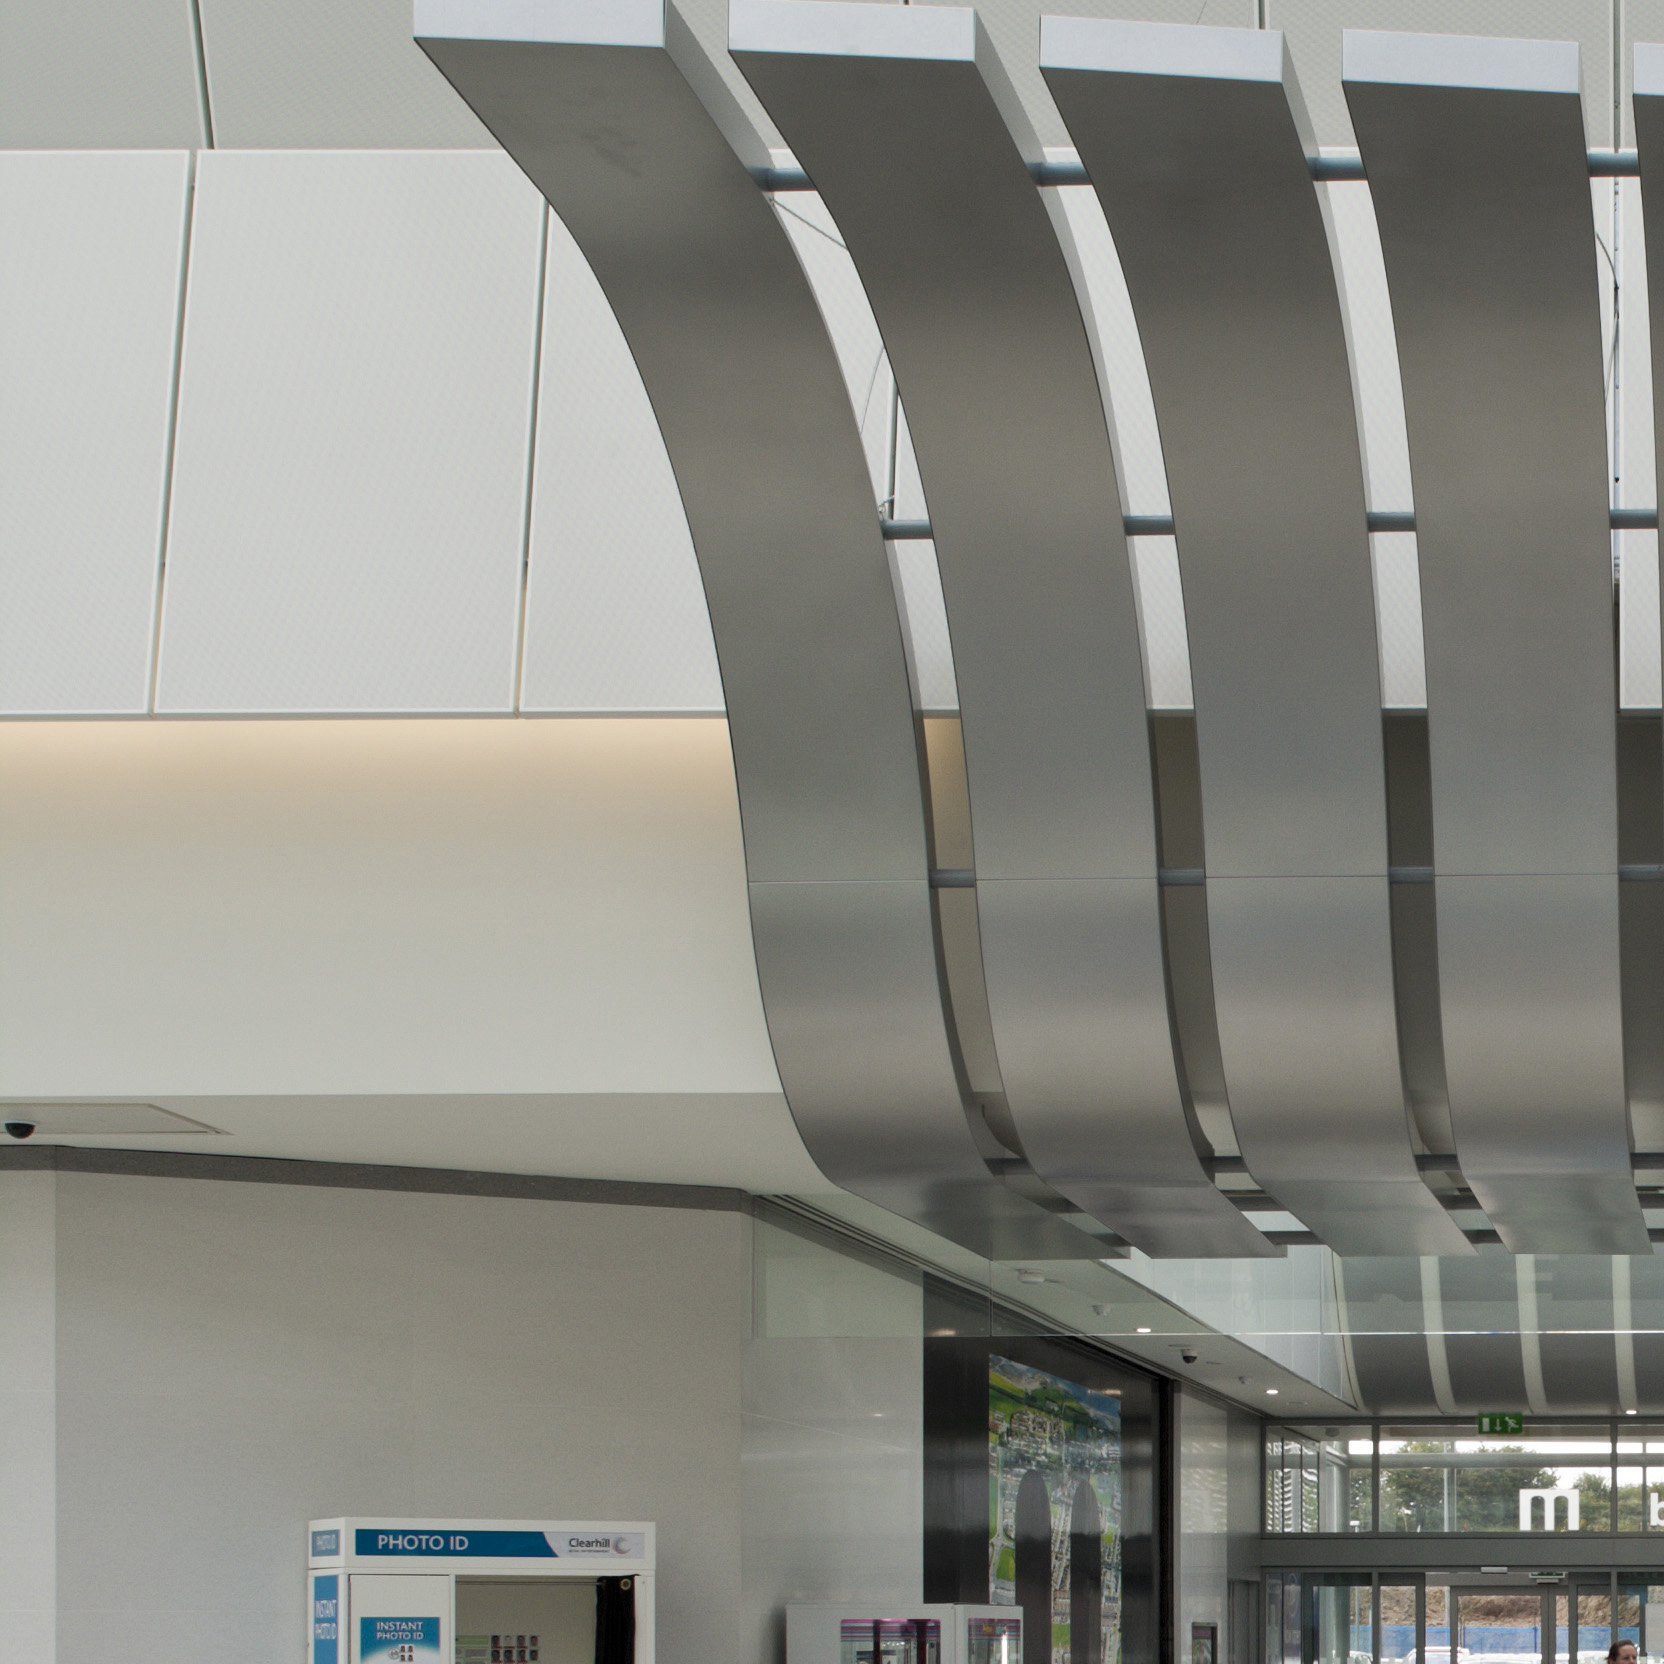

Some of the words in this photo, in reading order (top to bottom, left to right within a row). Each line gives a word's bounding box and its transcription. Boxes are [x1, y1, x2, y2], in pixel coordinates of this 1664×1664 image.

[377, 1534, 444, 1550] PHOTO
[450, 1535, 469, 1551] ID
[568, 1537, 611, 1548] Clearhill
[376, 1621, 424, 1631] INSTANT
[376, 1632, 411, 1640] PHOTO
[413, 1632, 424, 1640] ID
